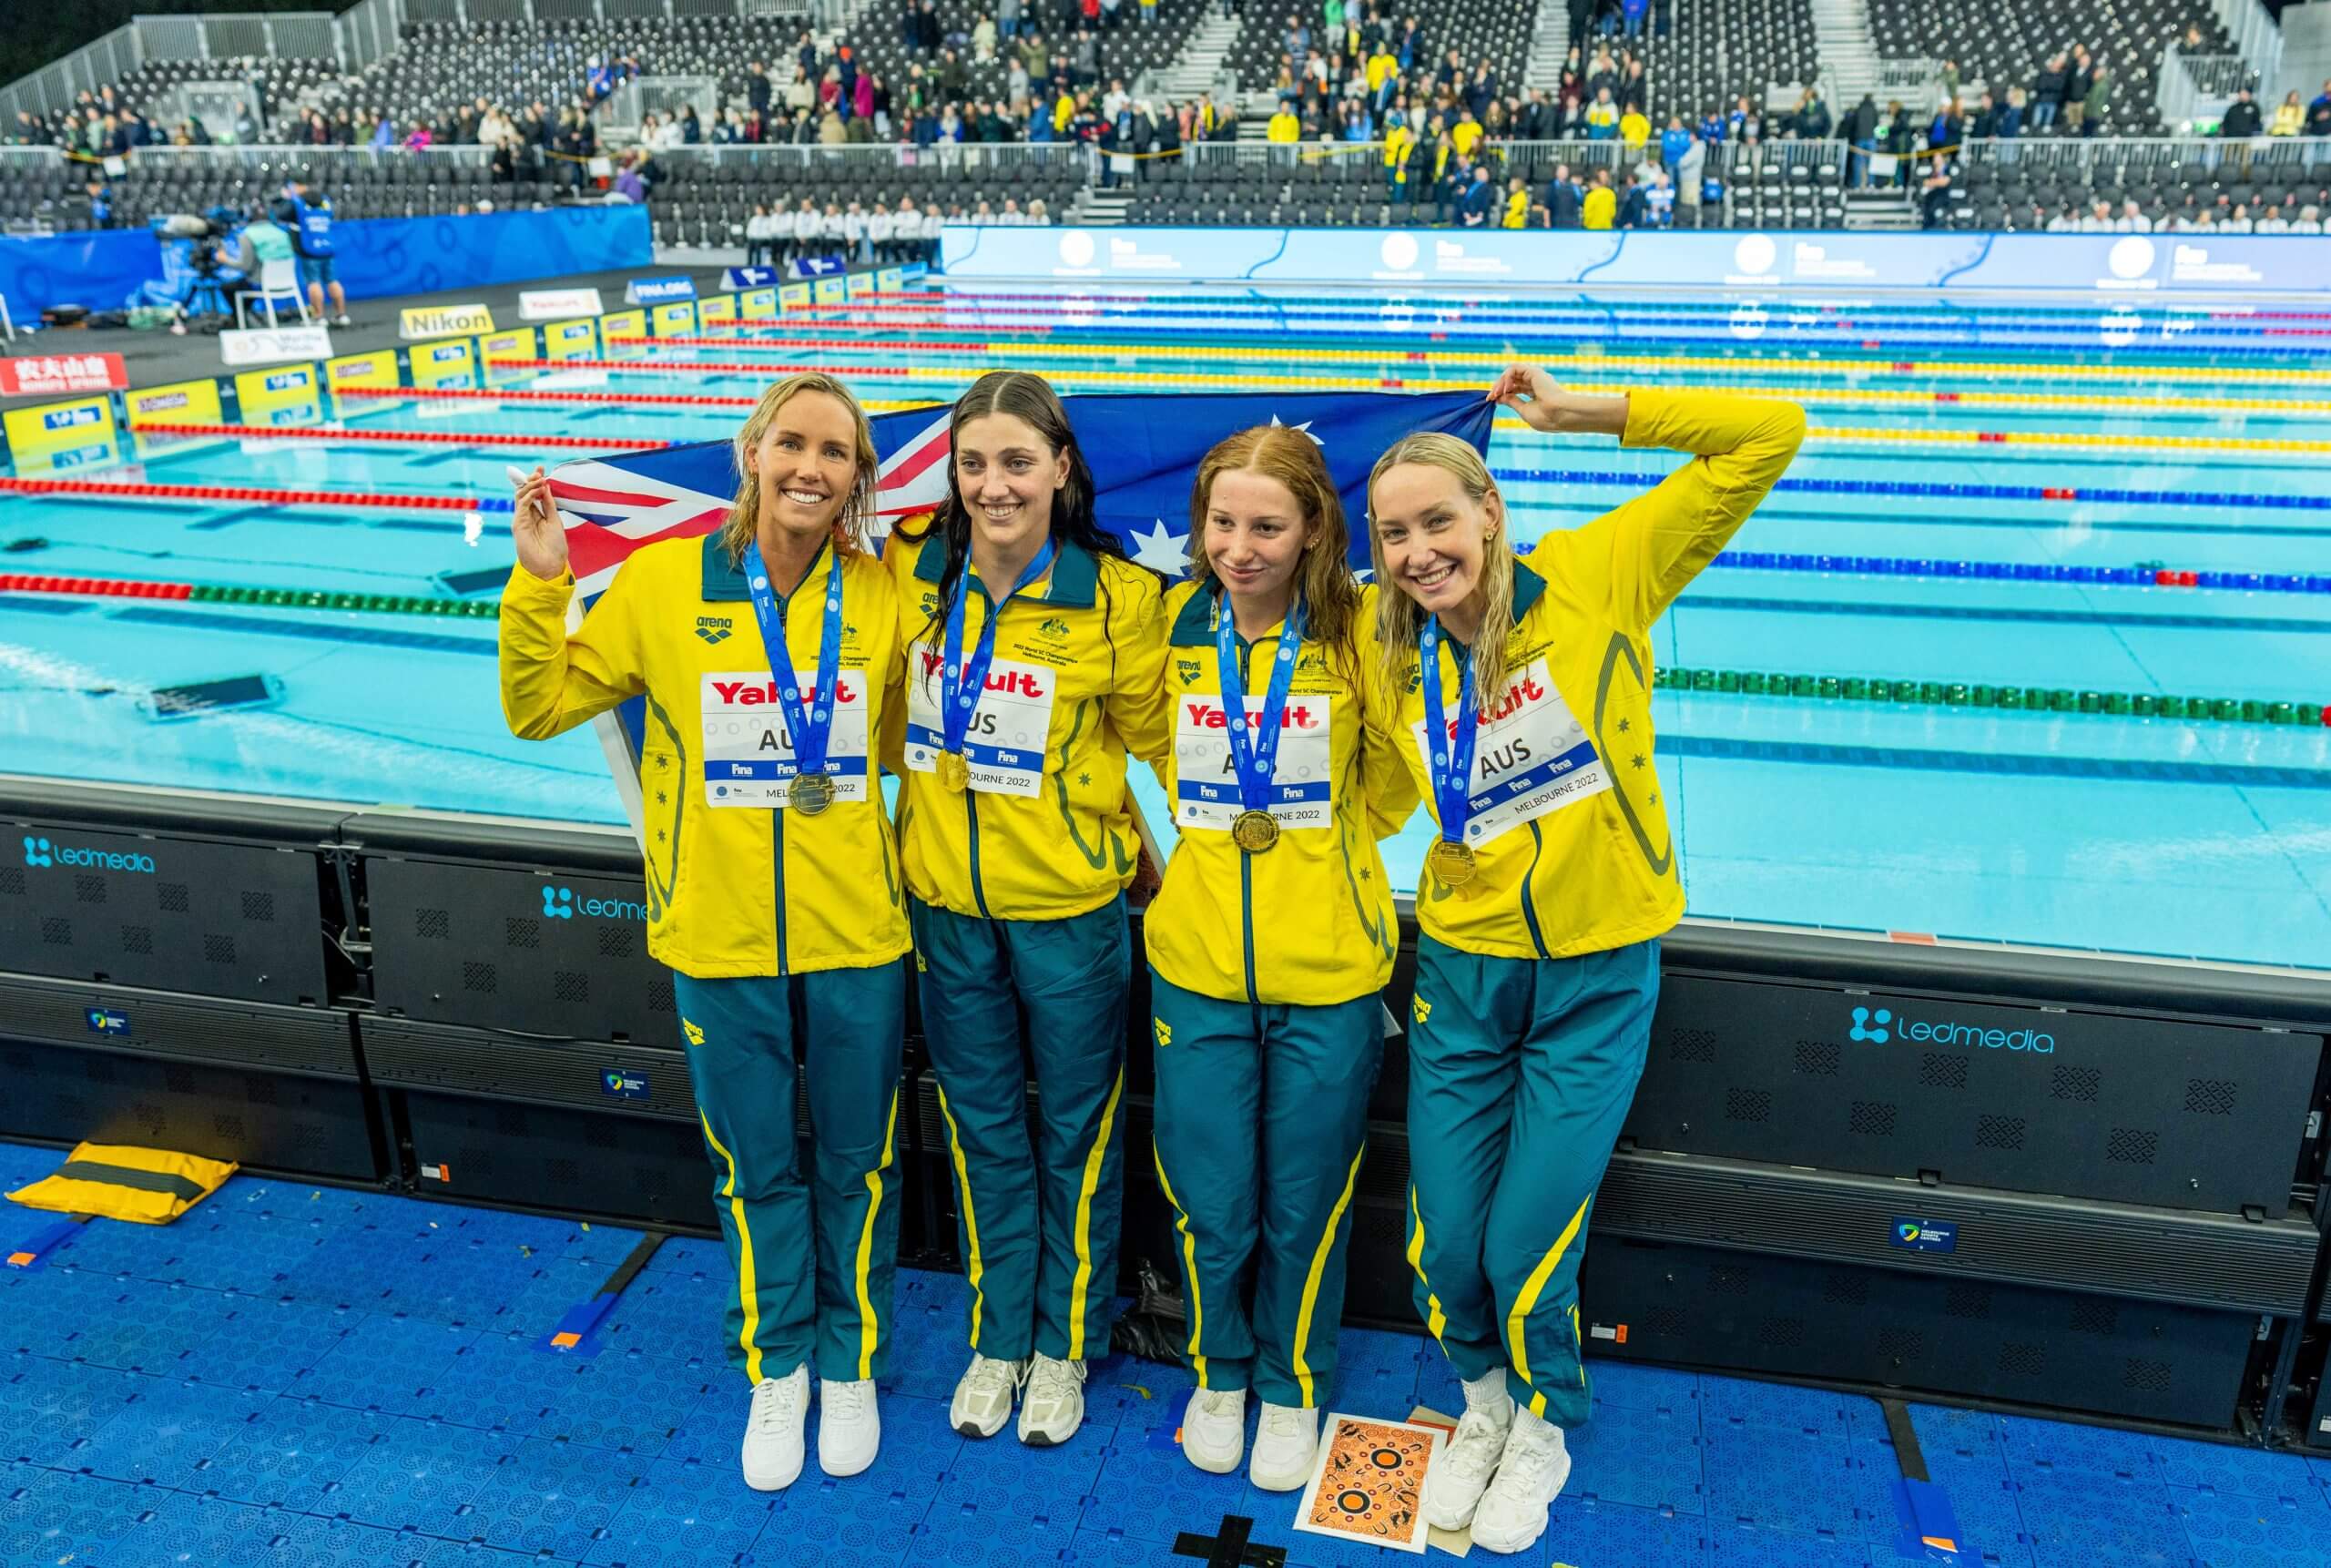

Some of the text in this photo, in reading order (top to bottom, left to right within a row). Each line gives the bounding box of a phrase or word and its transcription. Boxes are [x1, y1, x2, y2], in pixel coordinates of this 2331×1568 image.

[412, 313, 487, 333] Nikon
[922, 592, 938, 605] are
[697, 616, 732, 628] arena
[758, 729, 795, 751] AU
[1481, 738, 1532, 780] AUS
[1006, 776, 1031, 788] 2022
[1514, 772, 1599, 815] MELBOURNE 2022
[1296, 809, 1319, 820] 2022
